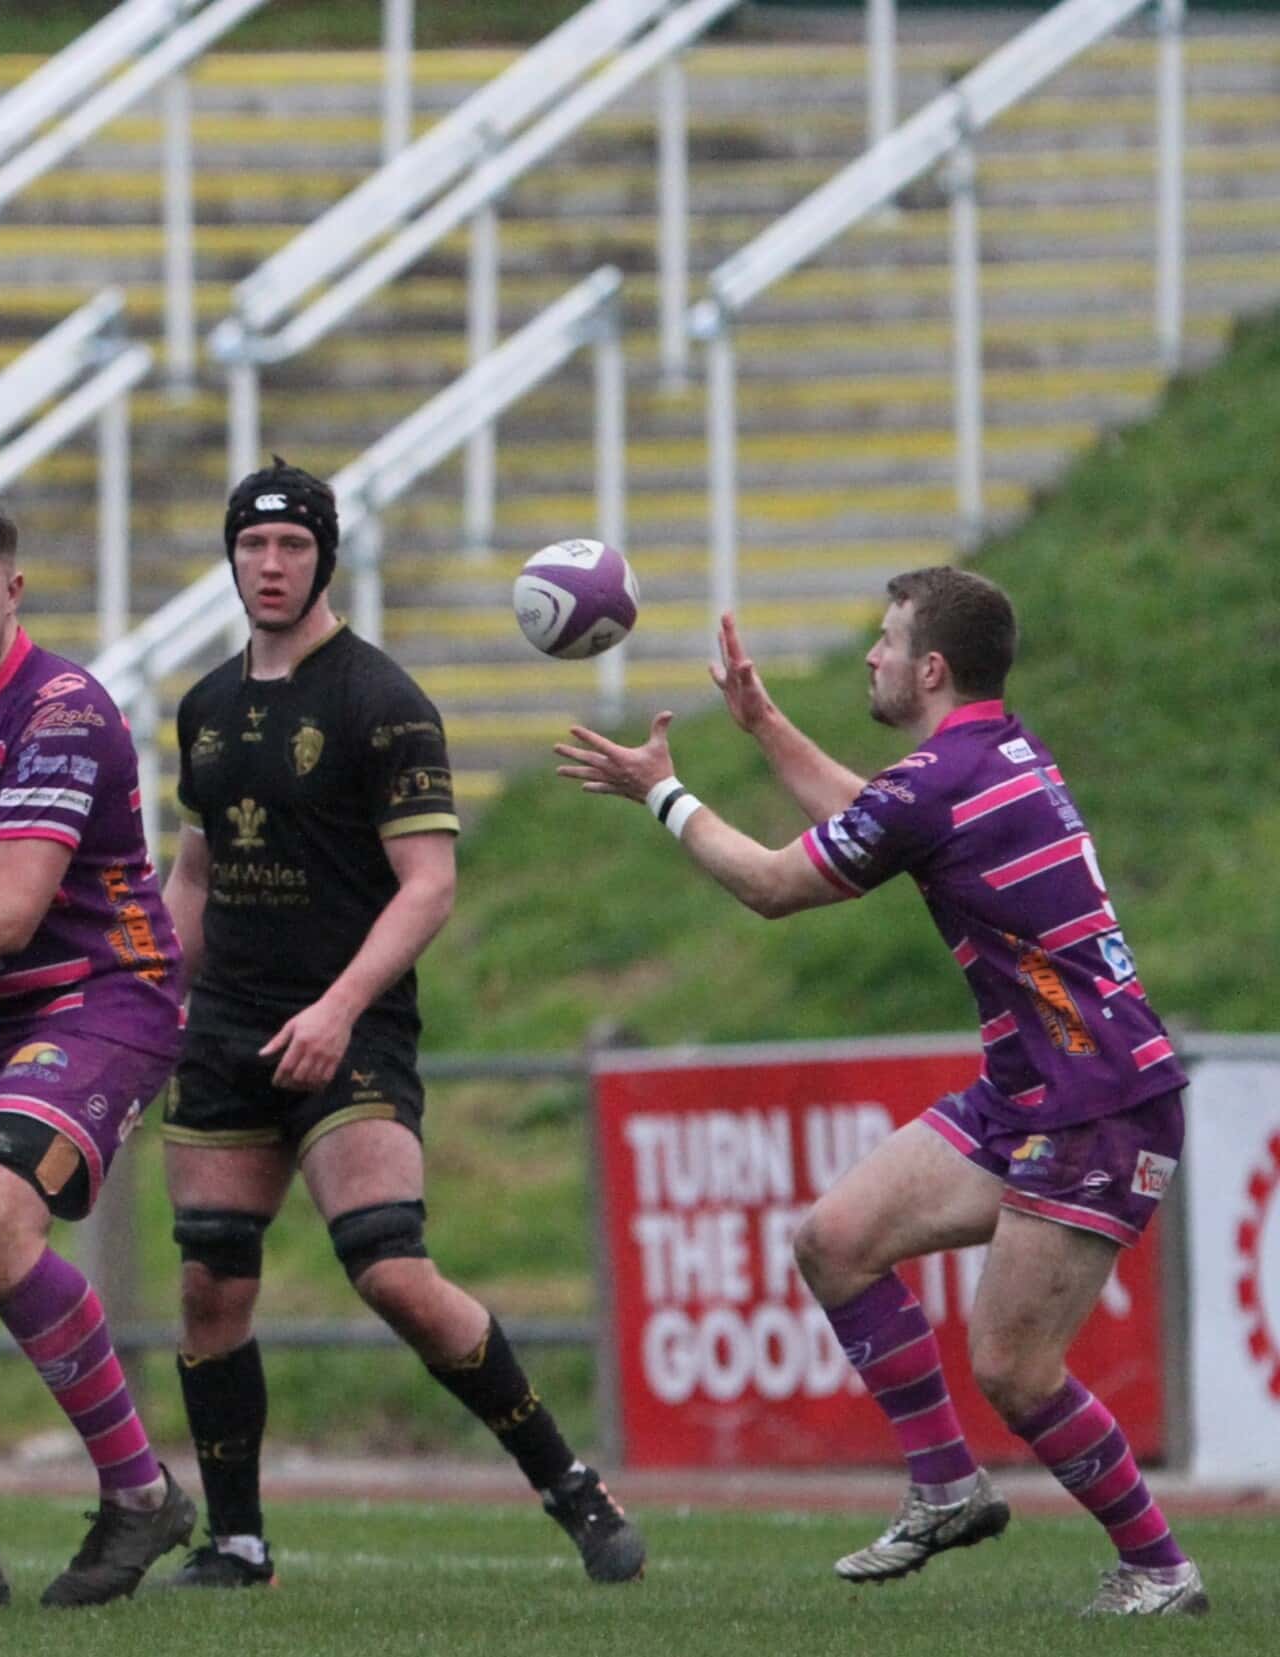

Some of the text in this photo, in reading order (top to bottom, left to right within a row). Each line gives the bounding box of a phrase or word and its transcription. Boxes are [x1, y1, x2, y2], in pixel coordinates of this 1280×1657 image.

[624, 1107, 794, 1205] TURN
[632, 1210, 751, 1303] THE
[642, 1304, 868, 1403] GOOD
